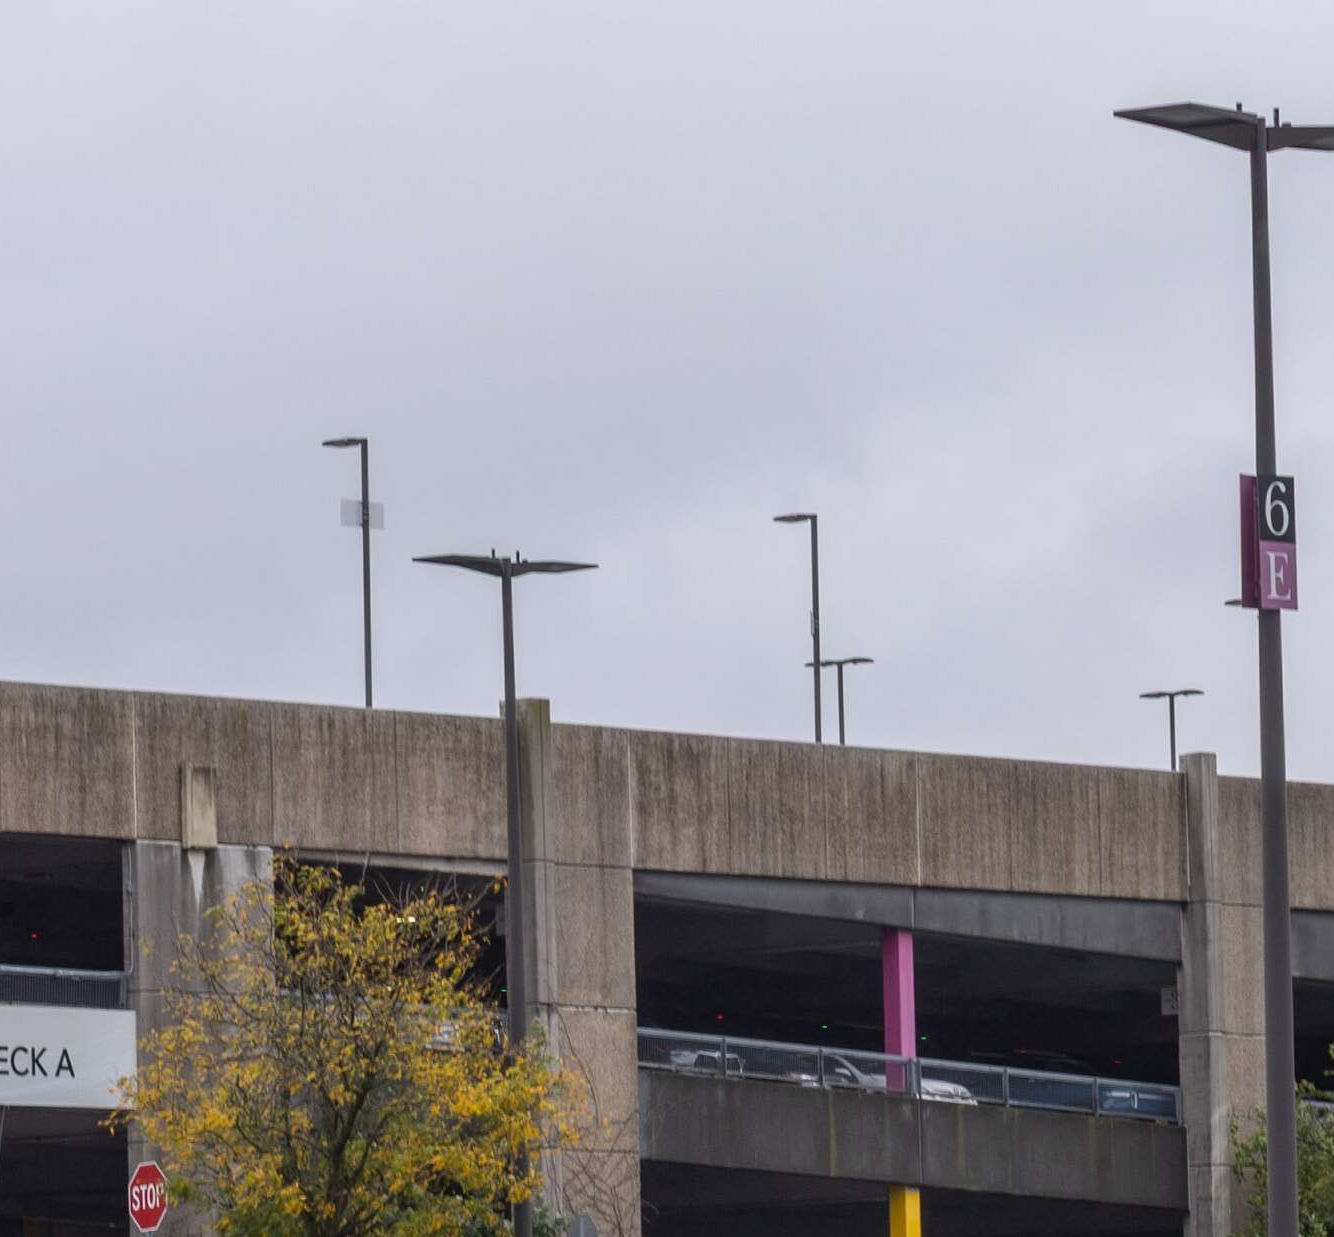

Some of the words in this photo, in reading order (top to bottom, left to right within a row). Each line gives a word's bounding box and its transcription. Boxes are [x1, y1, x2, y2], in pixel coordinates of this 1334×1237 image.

[1265, 480, 1290, 537] 6
[1266, 550, 1292, 601] E
[55, 1048, 76, 1078] A
[131, 1183, 164, 1212] STOP
